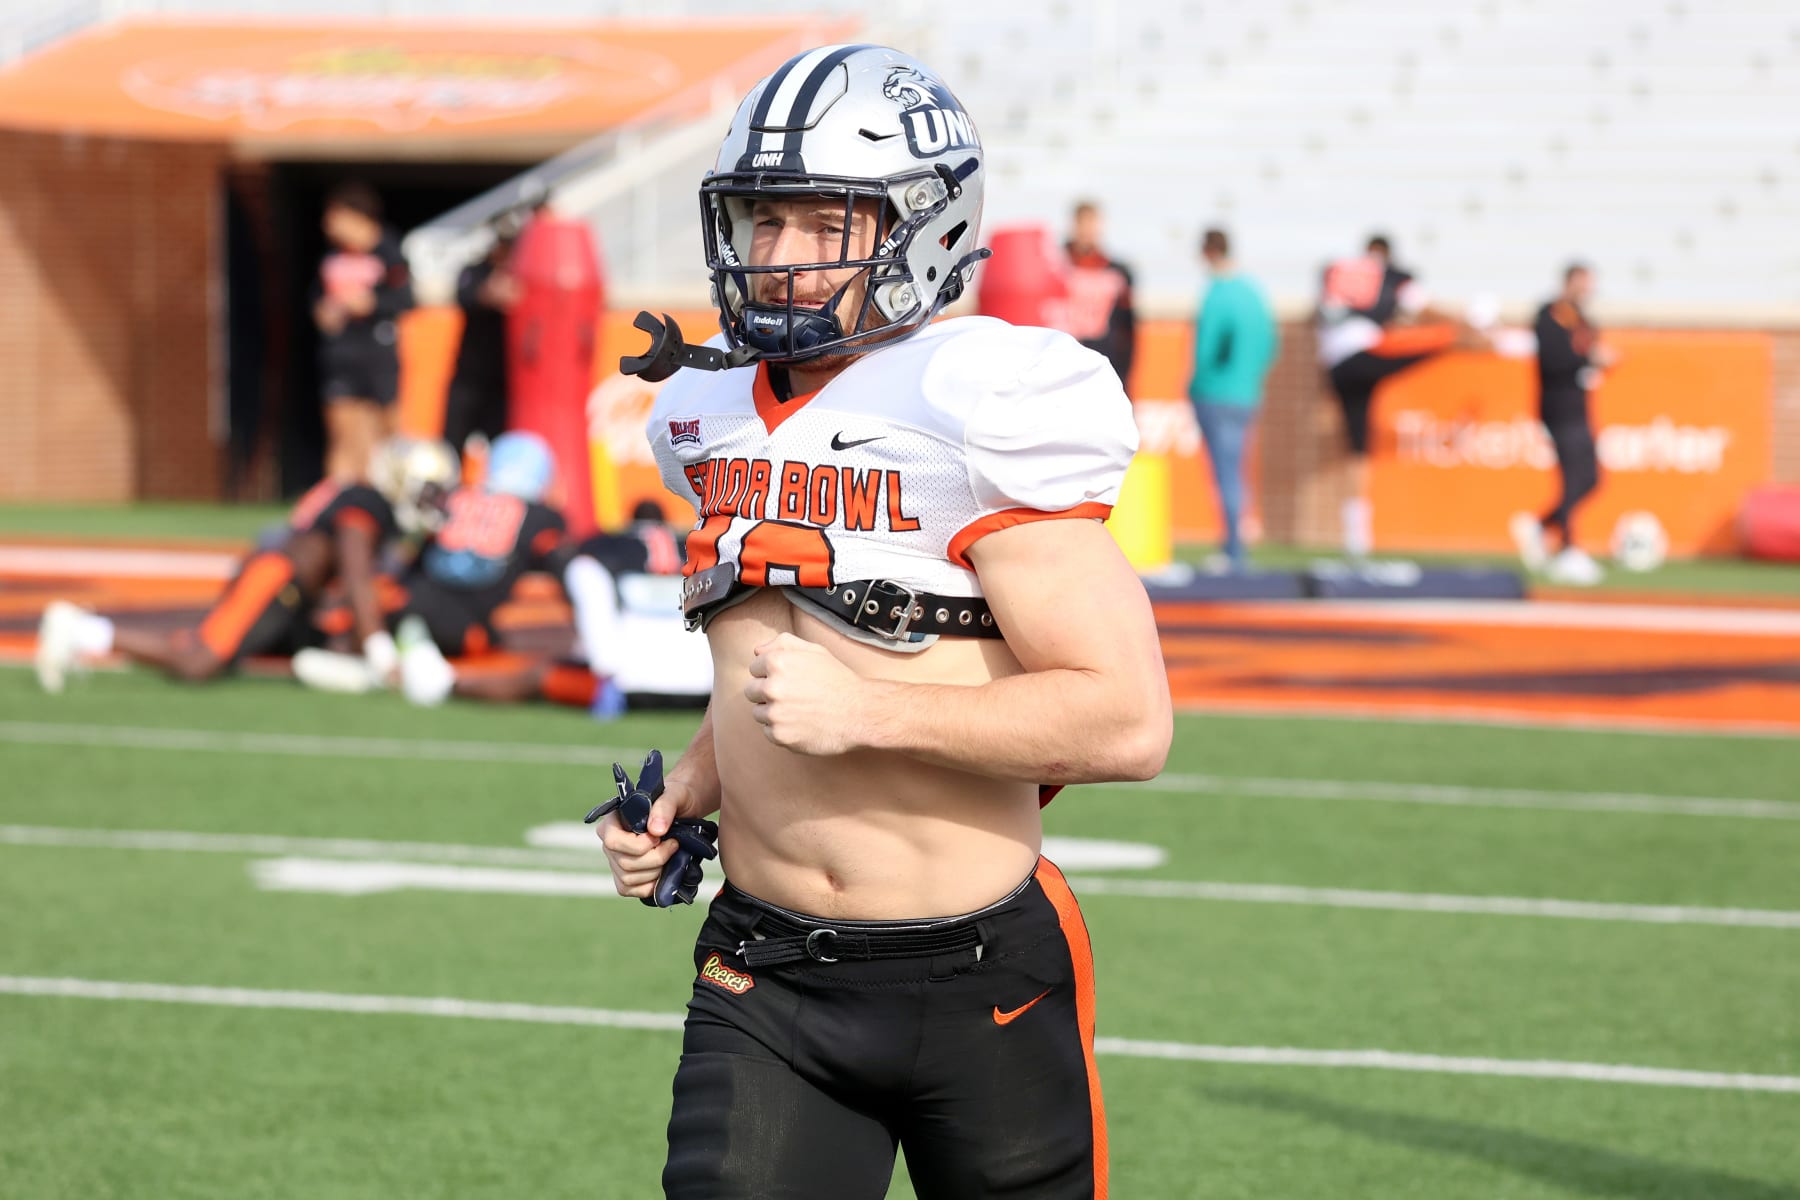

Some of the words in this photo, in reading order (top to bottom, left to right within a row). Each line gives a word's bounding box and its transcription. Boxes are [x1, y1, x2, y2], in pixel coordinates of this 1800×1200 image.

[752, 152, 784, 168] UNH
[753, 315, 783, 326] Riddell
[777, 459, 922, 532] BOWL
[702, 955, 750, 991] Reese's
